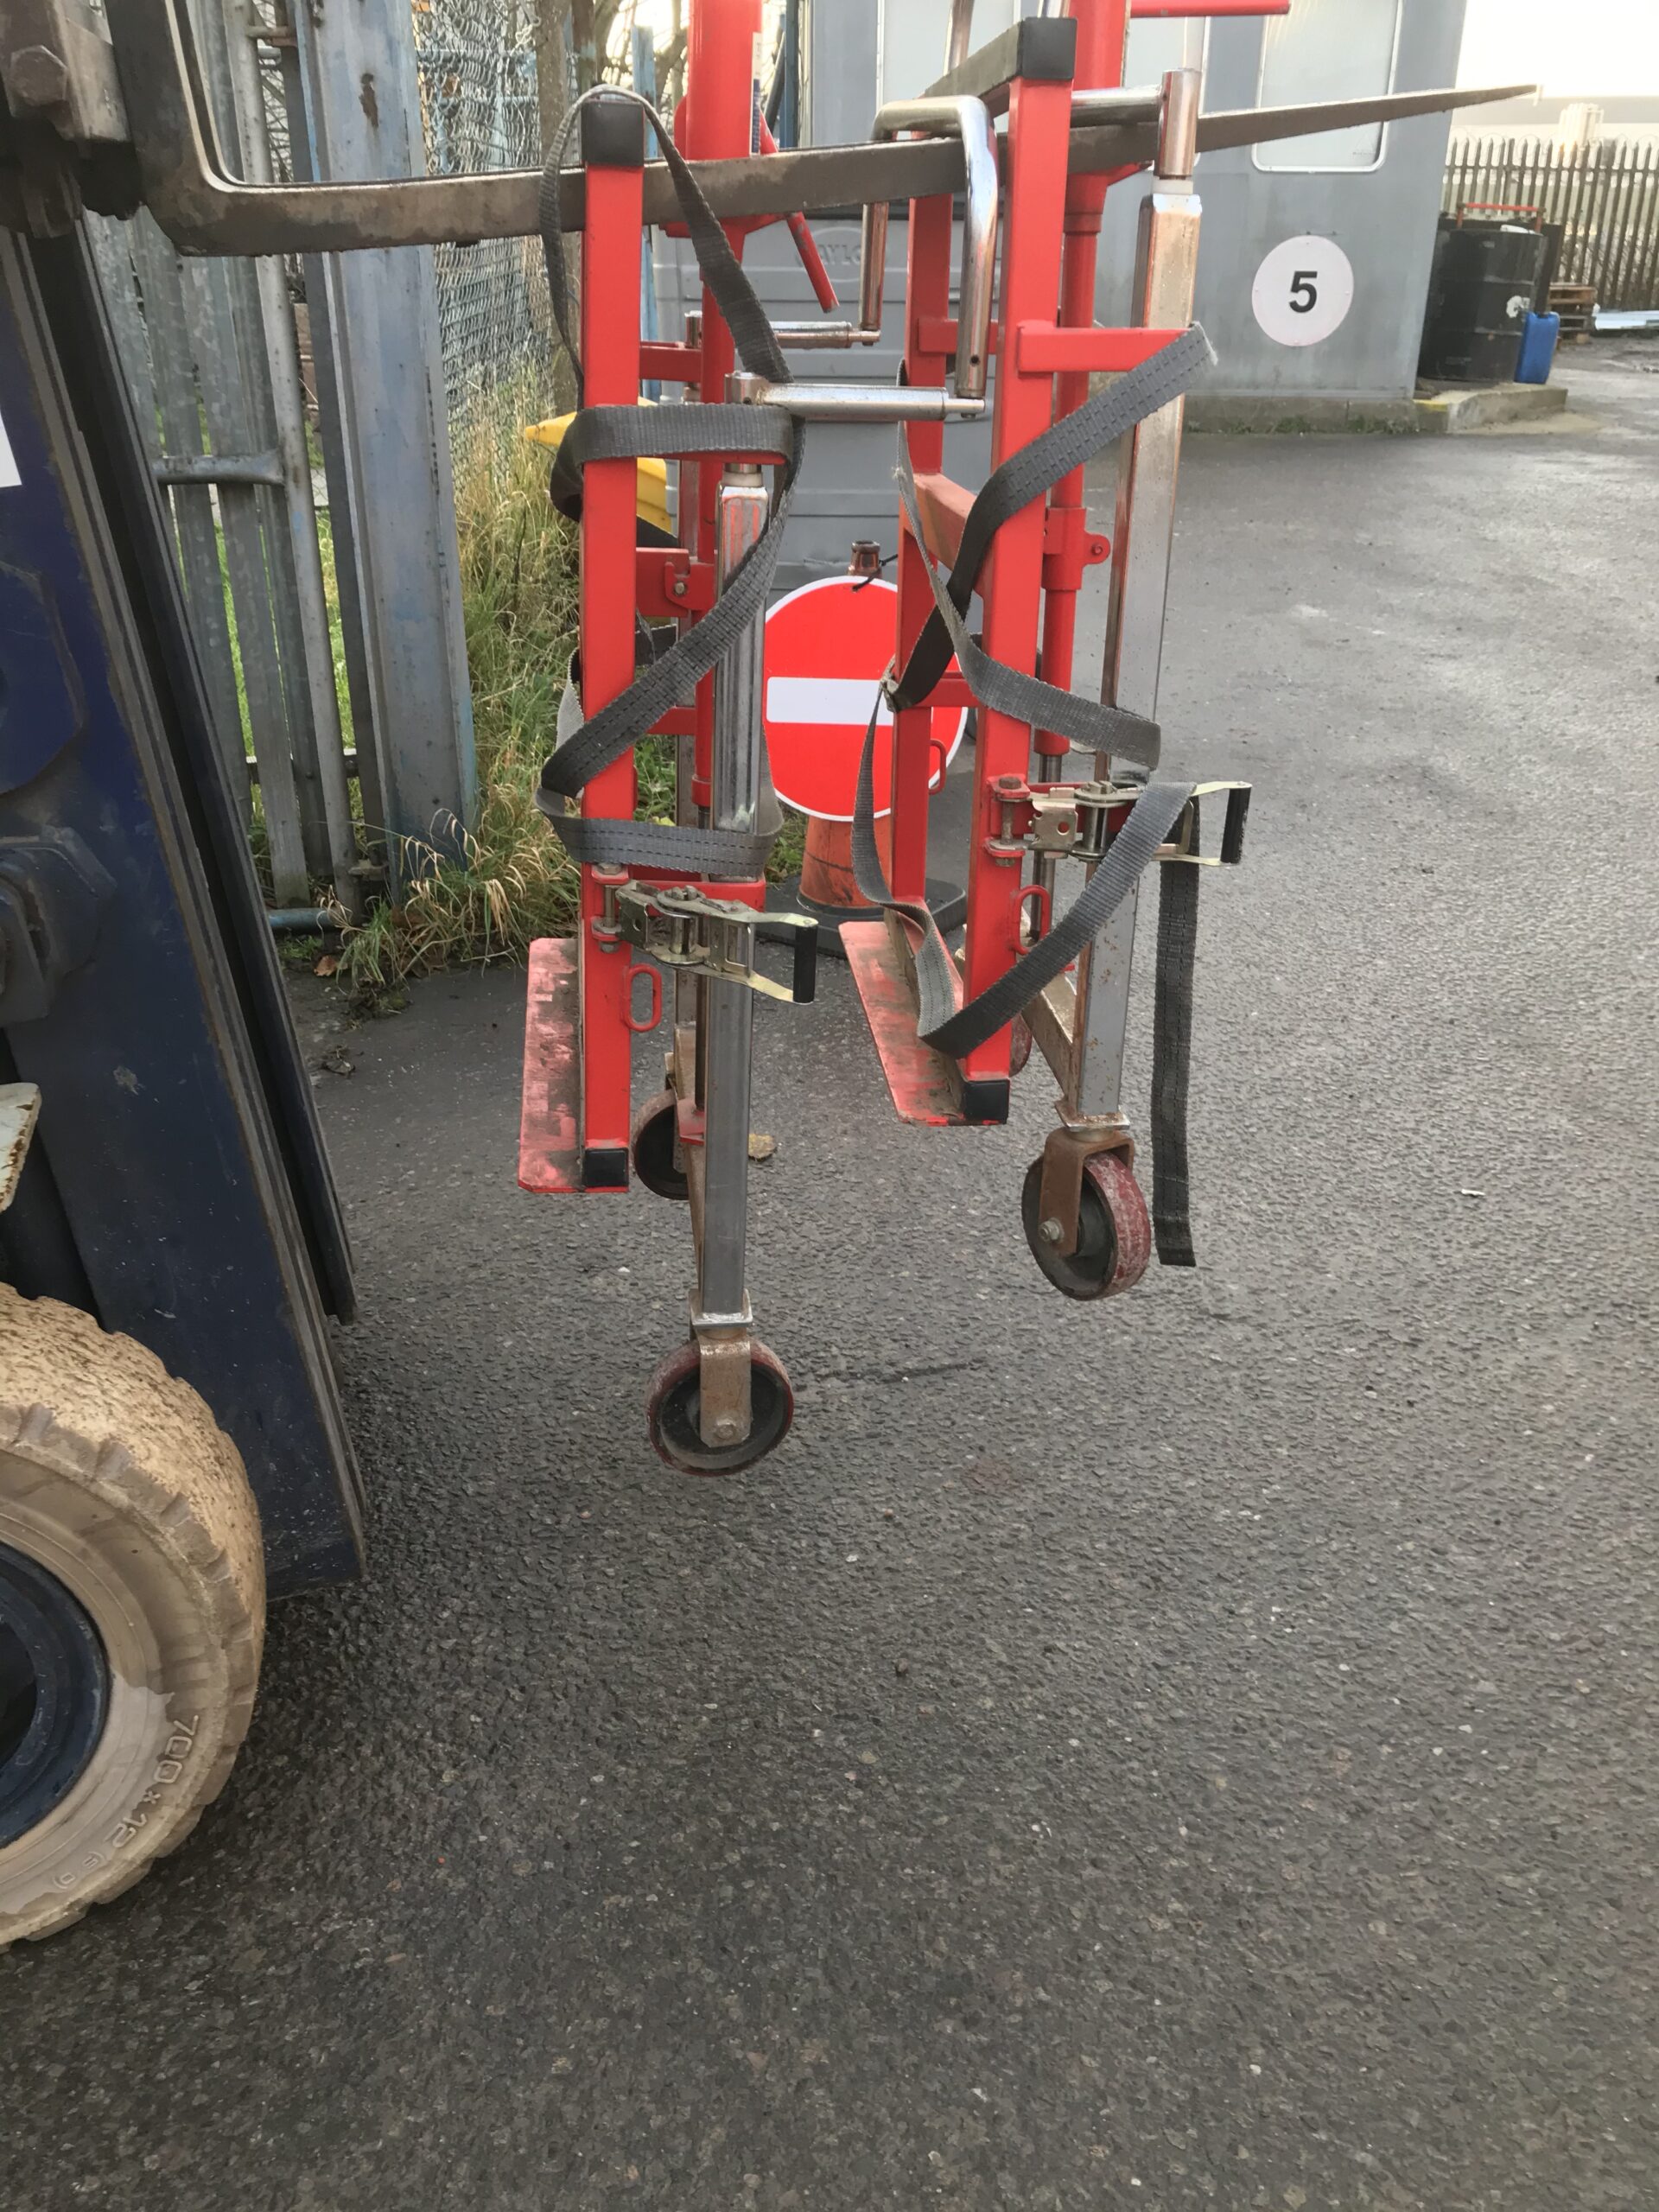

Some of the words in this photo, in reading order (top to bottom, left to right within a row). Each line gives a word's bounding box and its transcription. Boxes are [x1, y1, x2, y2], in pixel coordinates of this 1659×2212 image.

[1289, 270, 1318, 314] 5
[154, 1715, 200, 1783] 700
[105, 1813, 148, 1848] 12
